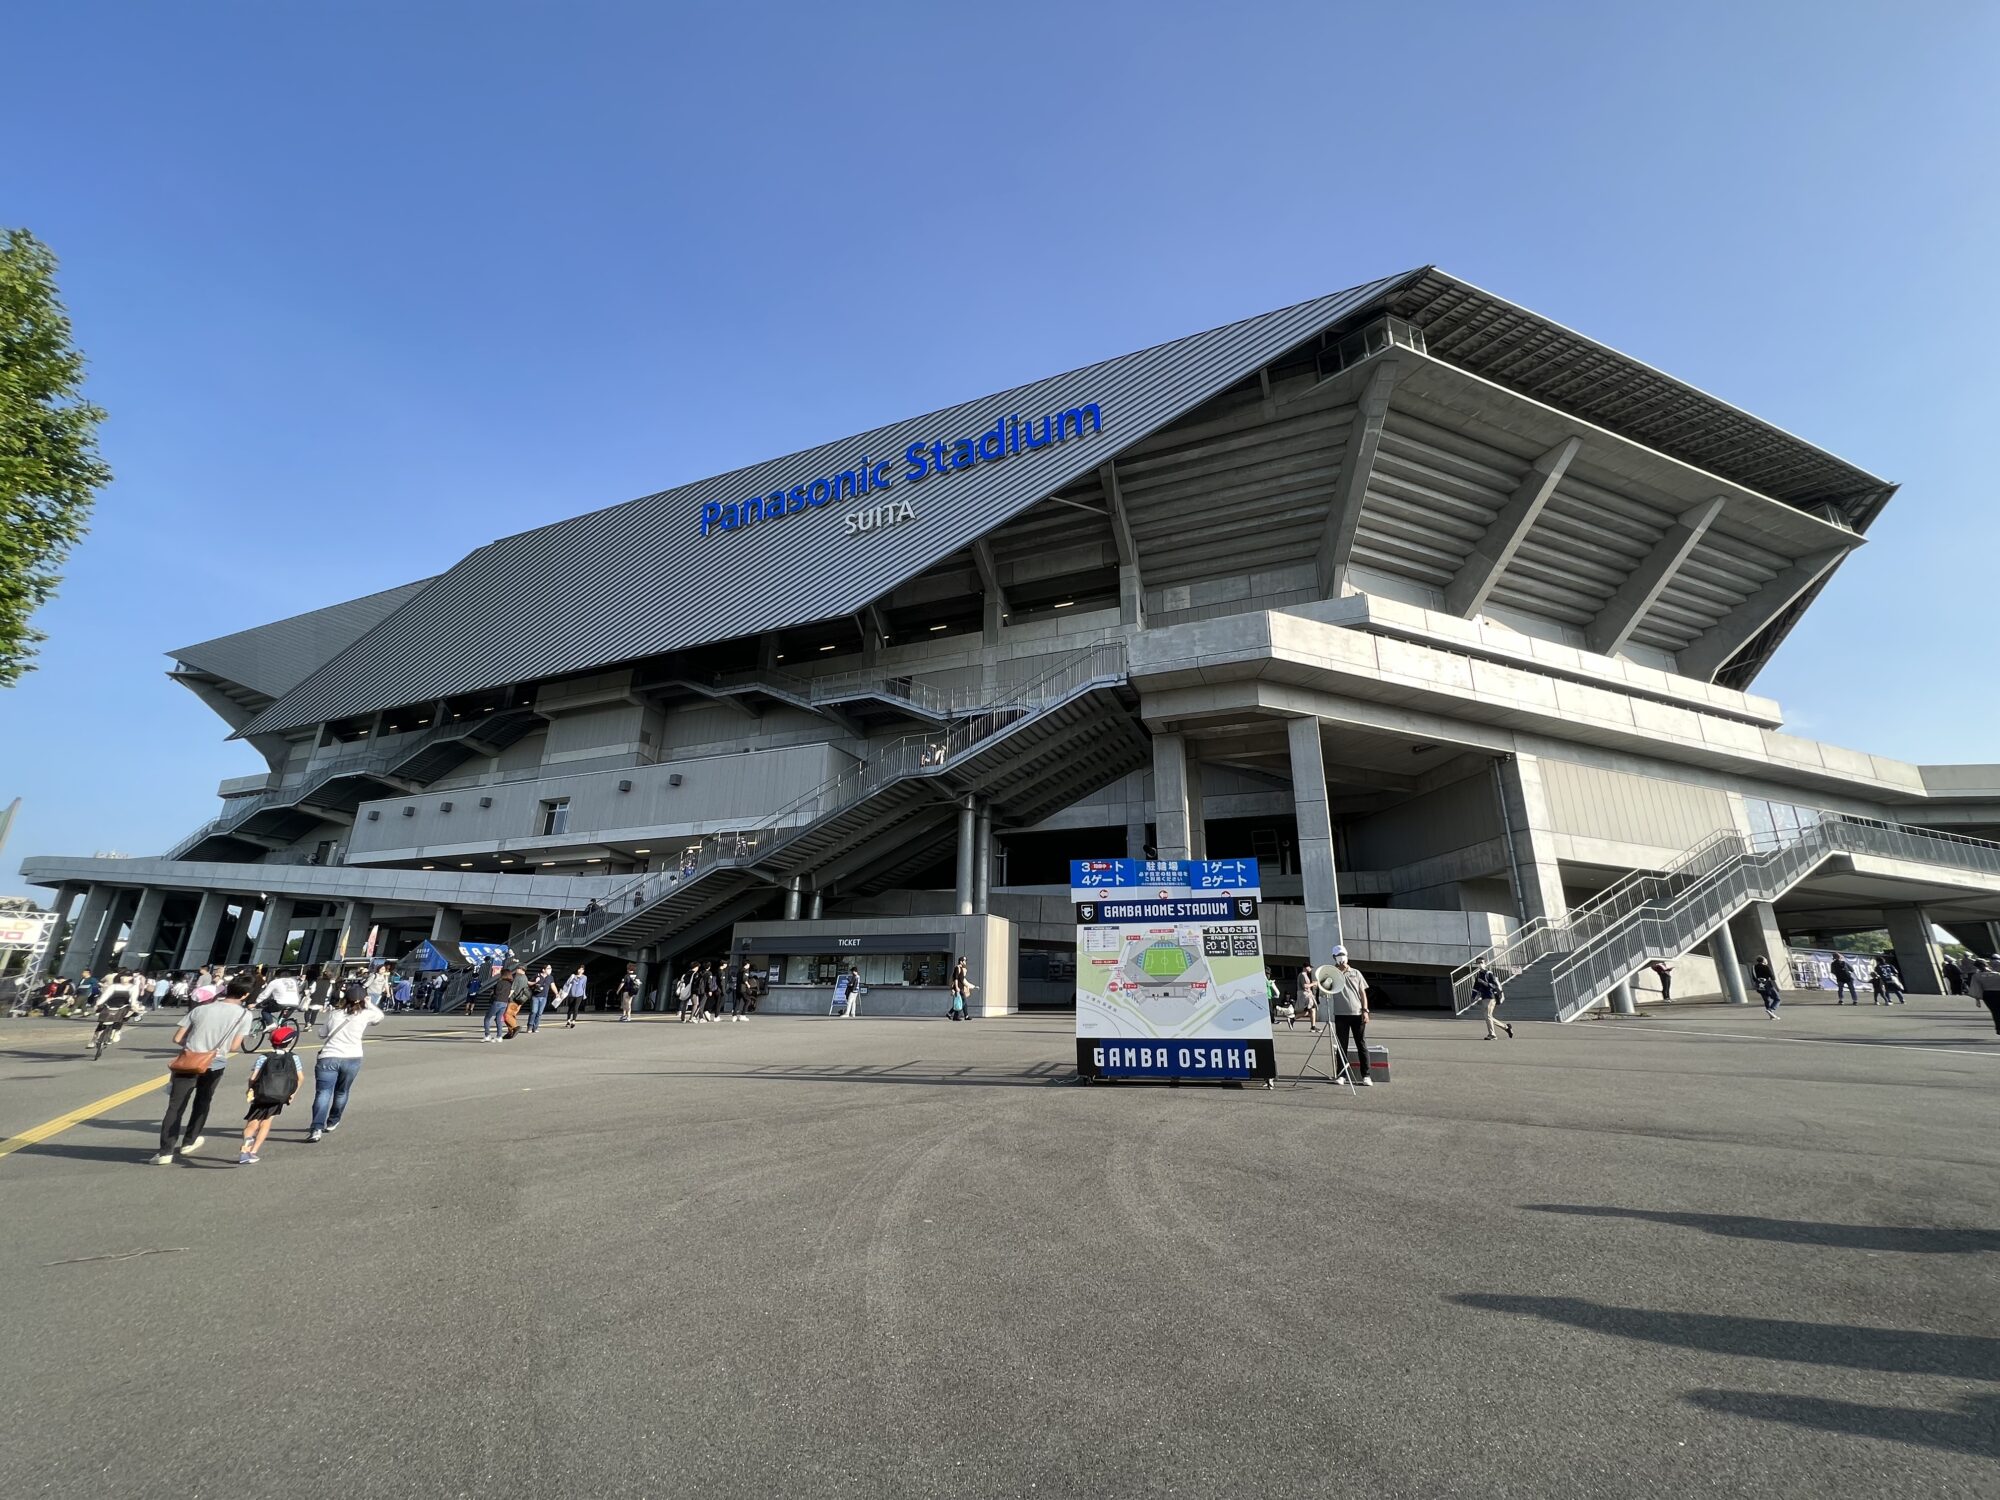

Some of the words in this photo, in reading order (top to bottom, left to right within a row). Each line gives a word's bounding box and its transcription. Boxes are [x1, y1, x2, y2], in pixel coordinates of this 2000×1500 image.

[701, 456, 893, 538] Panasonic
[905, 401, 1103, 482] Stadium
[844, 499, 917, 536] SUITA
[1145, 861, 1178, 872] 駐輪場
[1202, 862, 1246, 873] 1ゲート
[1081, 875, 1125, 886] 4ゲート
[1202, 876, 1248, 887] 2ゲート
[1104, 904, 1142, 918] GAMBA
[1144, 903, 1175, 917] HOME
[1177, 902, 1228, 916] STADIUM
[531, 939, 537, 953] 1
[838, 938, 861, 946] TICKET
[1093, 1047, 1169, 1068] GAMBA
[1178, 1047, 1257, 1069] OSAKA
